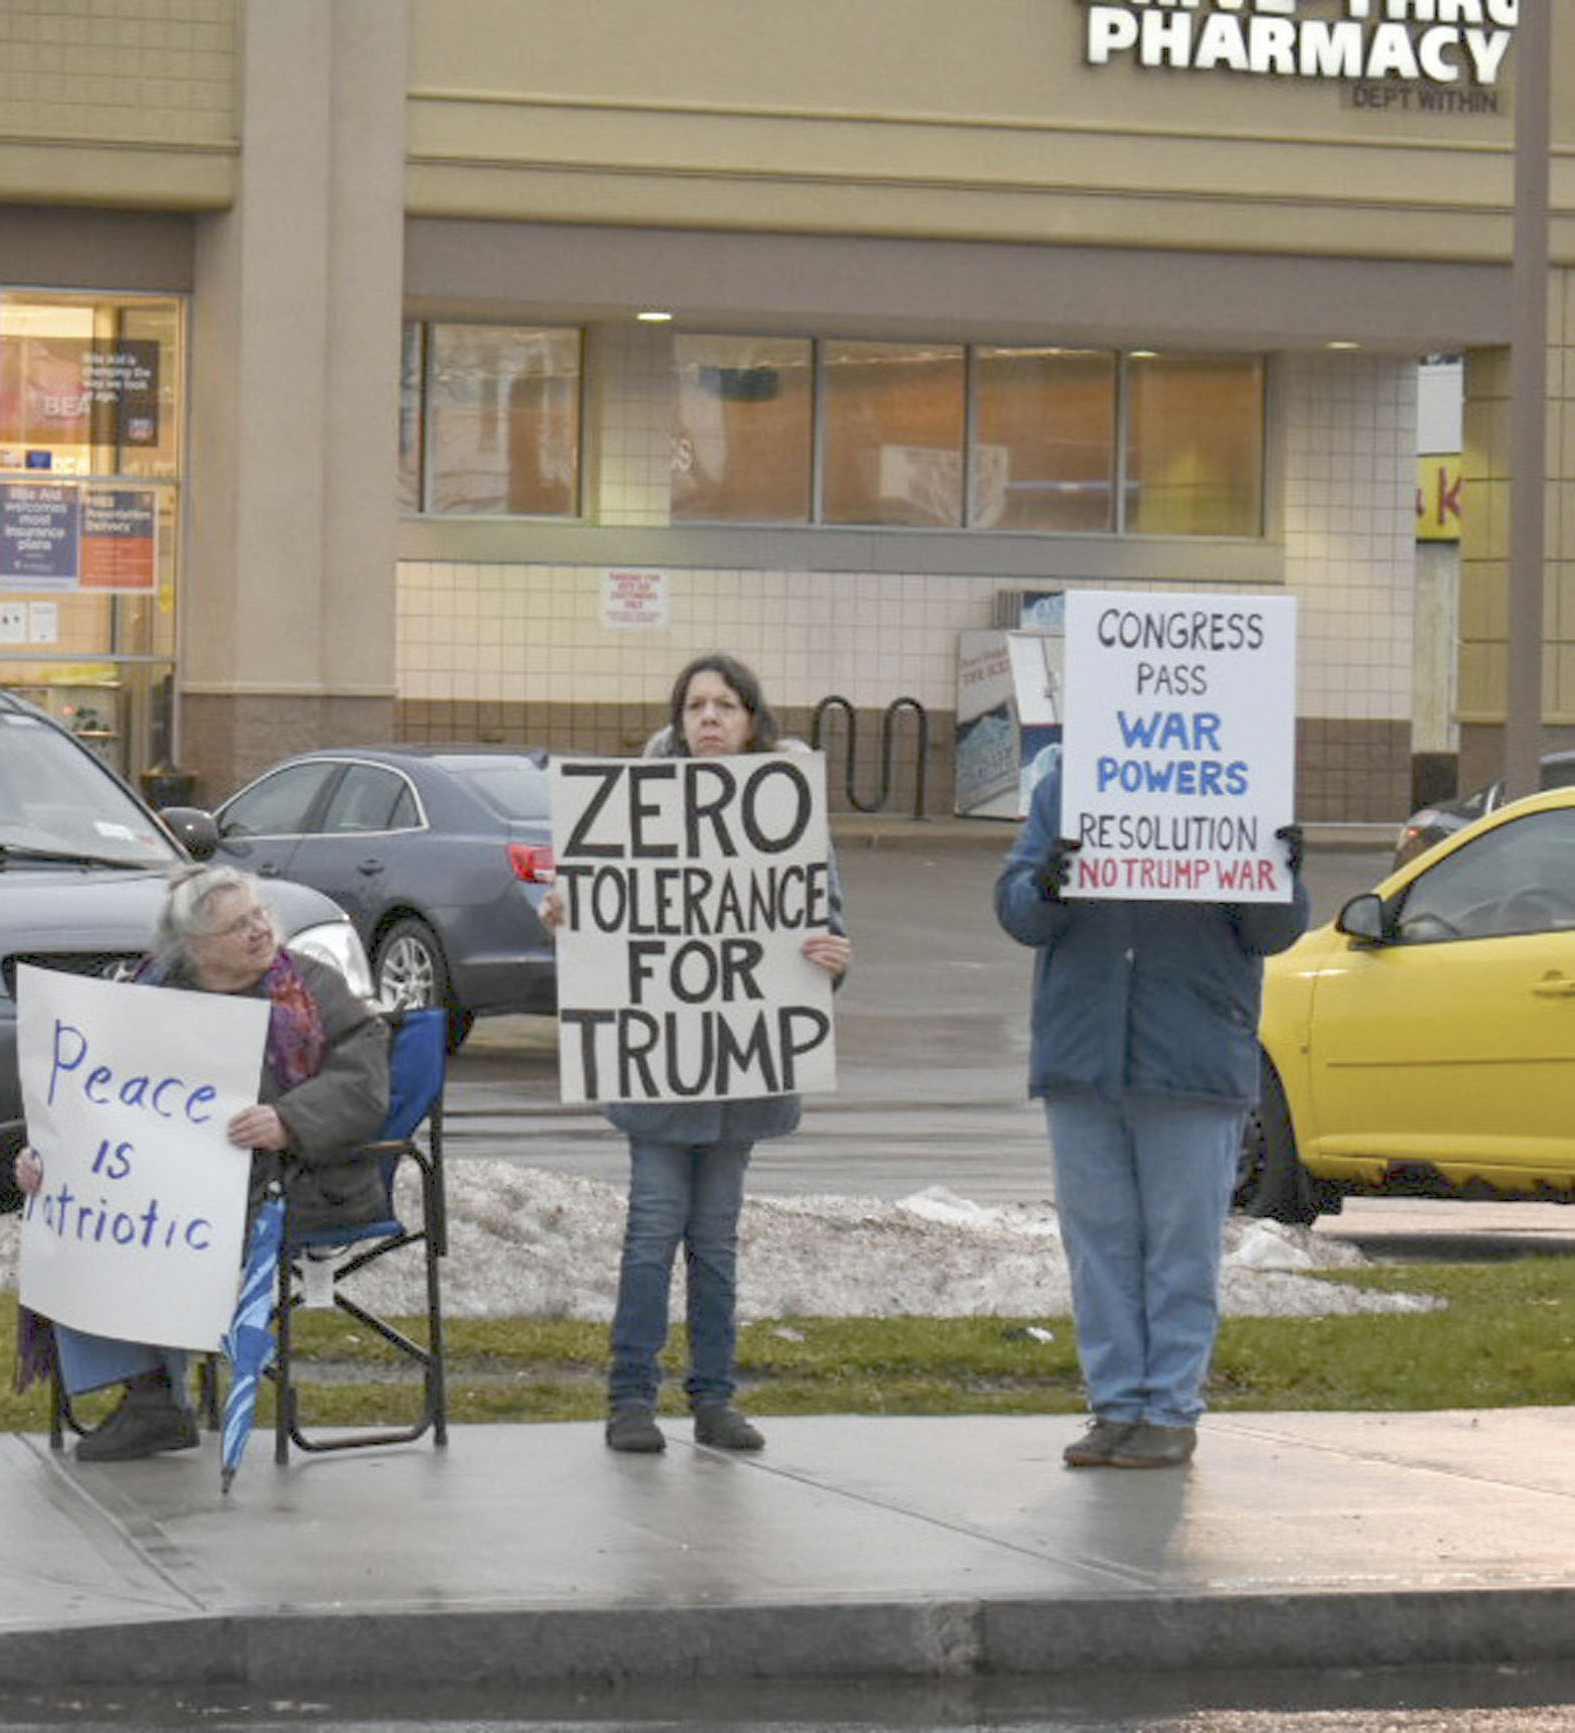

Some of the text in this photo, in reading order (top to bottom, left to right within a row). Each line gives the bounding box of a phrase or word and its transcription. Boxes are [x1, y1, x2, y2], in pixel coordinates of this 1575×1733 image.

[1087, 5, 1511, 84] PHARMACY
[1351, 85, 1499, 114] DEPT WITHIN
[1097, 608, 1264, 651] CONGRESS
[1136, 661, 1208, 696] PASS
[1116, 709, 1222, 752] WAR
[1096, 756, 1249, 797] POWERS
[560, 760, 813, 859] ZERO
[1079, 812, 1258, 852] RESOLUTION
[554, 861, 830, 936] TOLERANCE
[1078, 857, 1277, 891] NO TRUMP WAR
[627, 938, 766, 1005] FOR
[46, 1018, 218, 1125] Peace
[560, 1005, 831, 1101] TRUMP
[26, 1182, 213, 1252] atriotic
